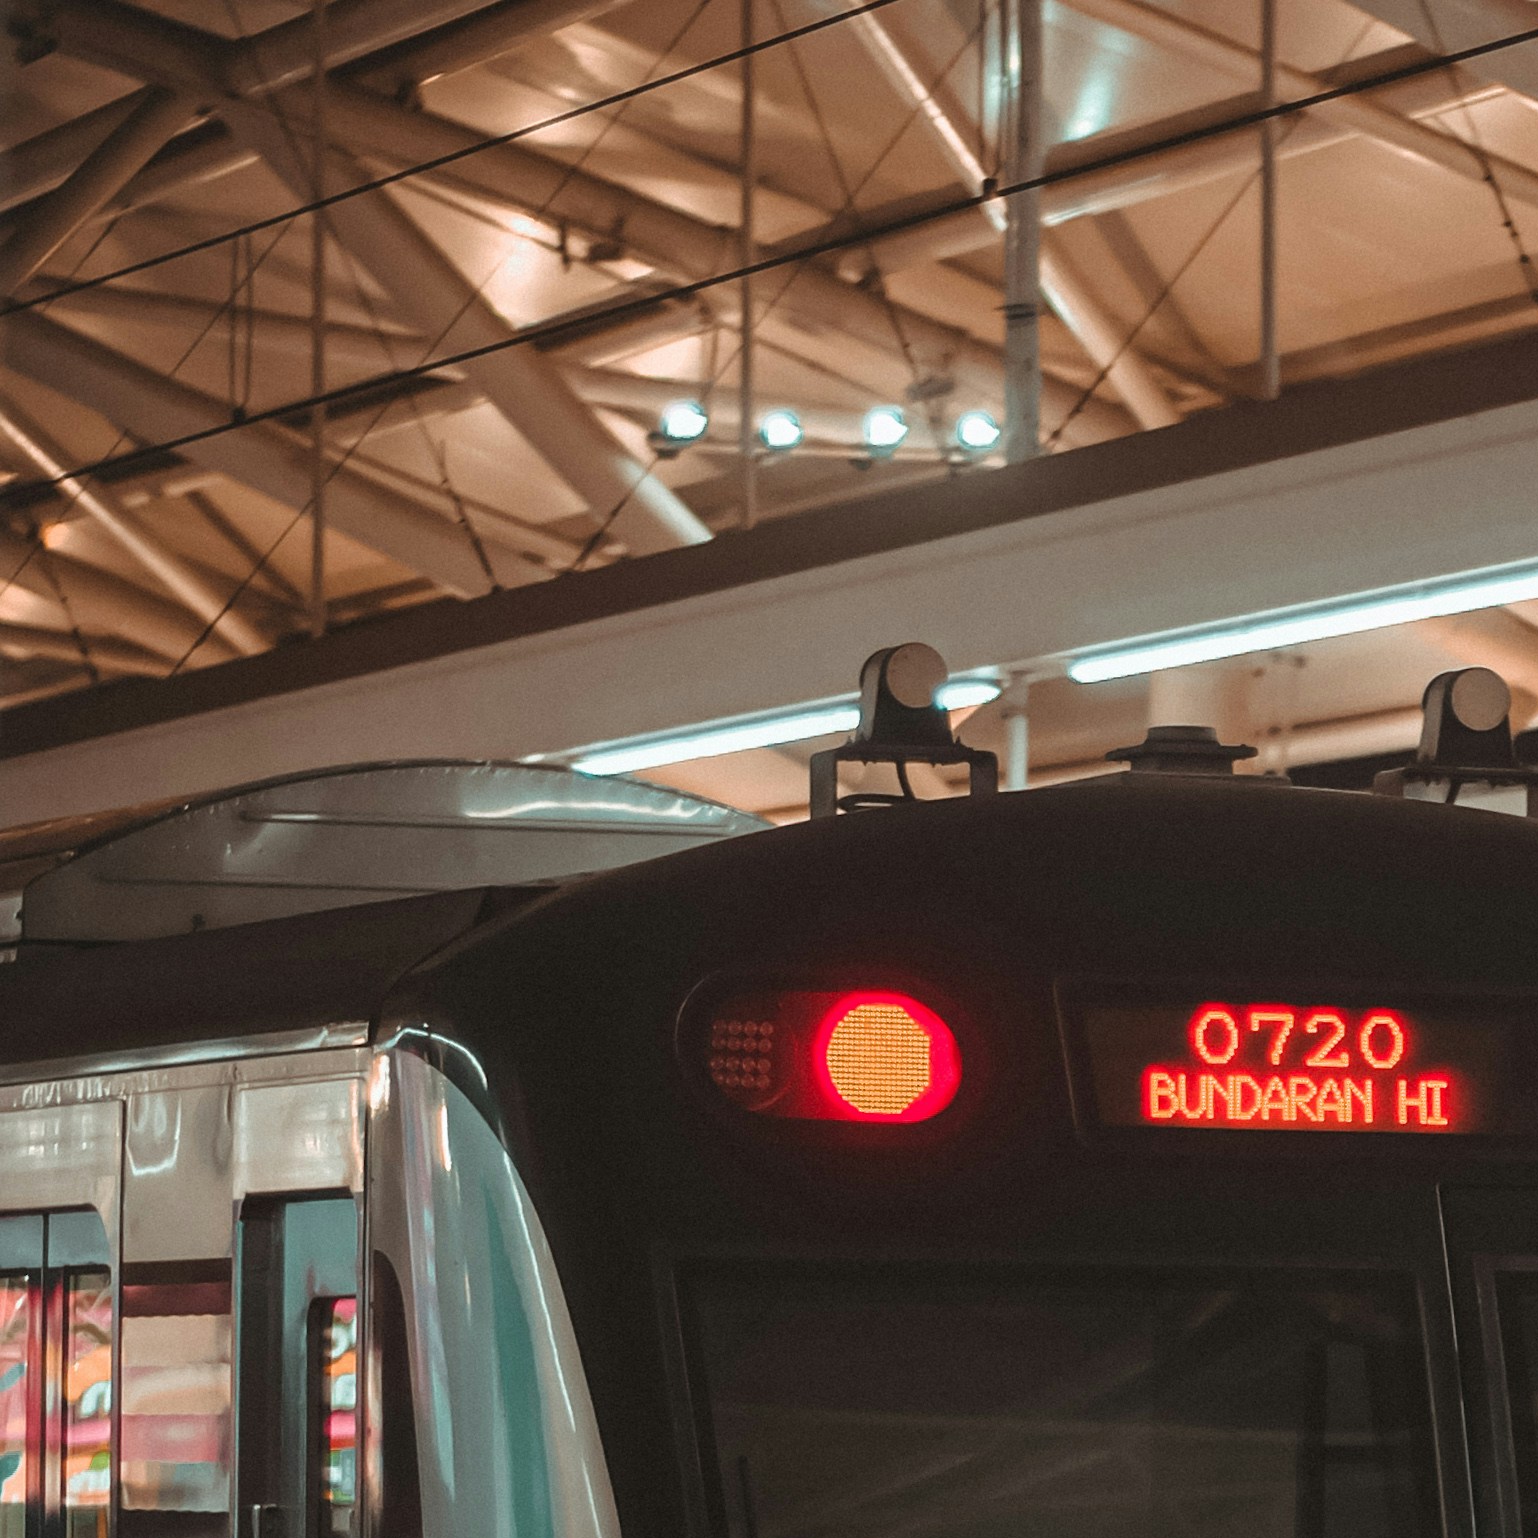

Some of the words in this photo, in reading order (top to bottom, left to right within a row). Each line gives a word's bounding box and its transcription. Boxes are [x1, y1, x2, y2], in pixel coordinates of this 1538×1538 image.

[1195, 1011, 1403, 1068] 0720
[1150, 1073, 1373, 1123] BUNDARAN
[1398, 1080, 1448, 1125] HI
